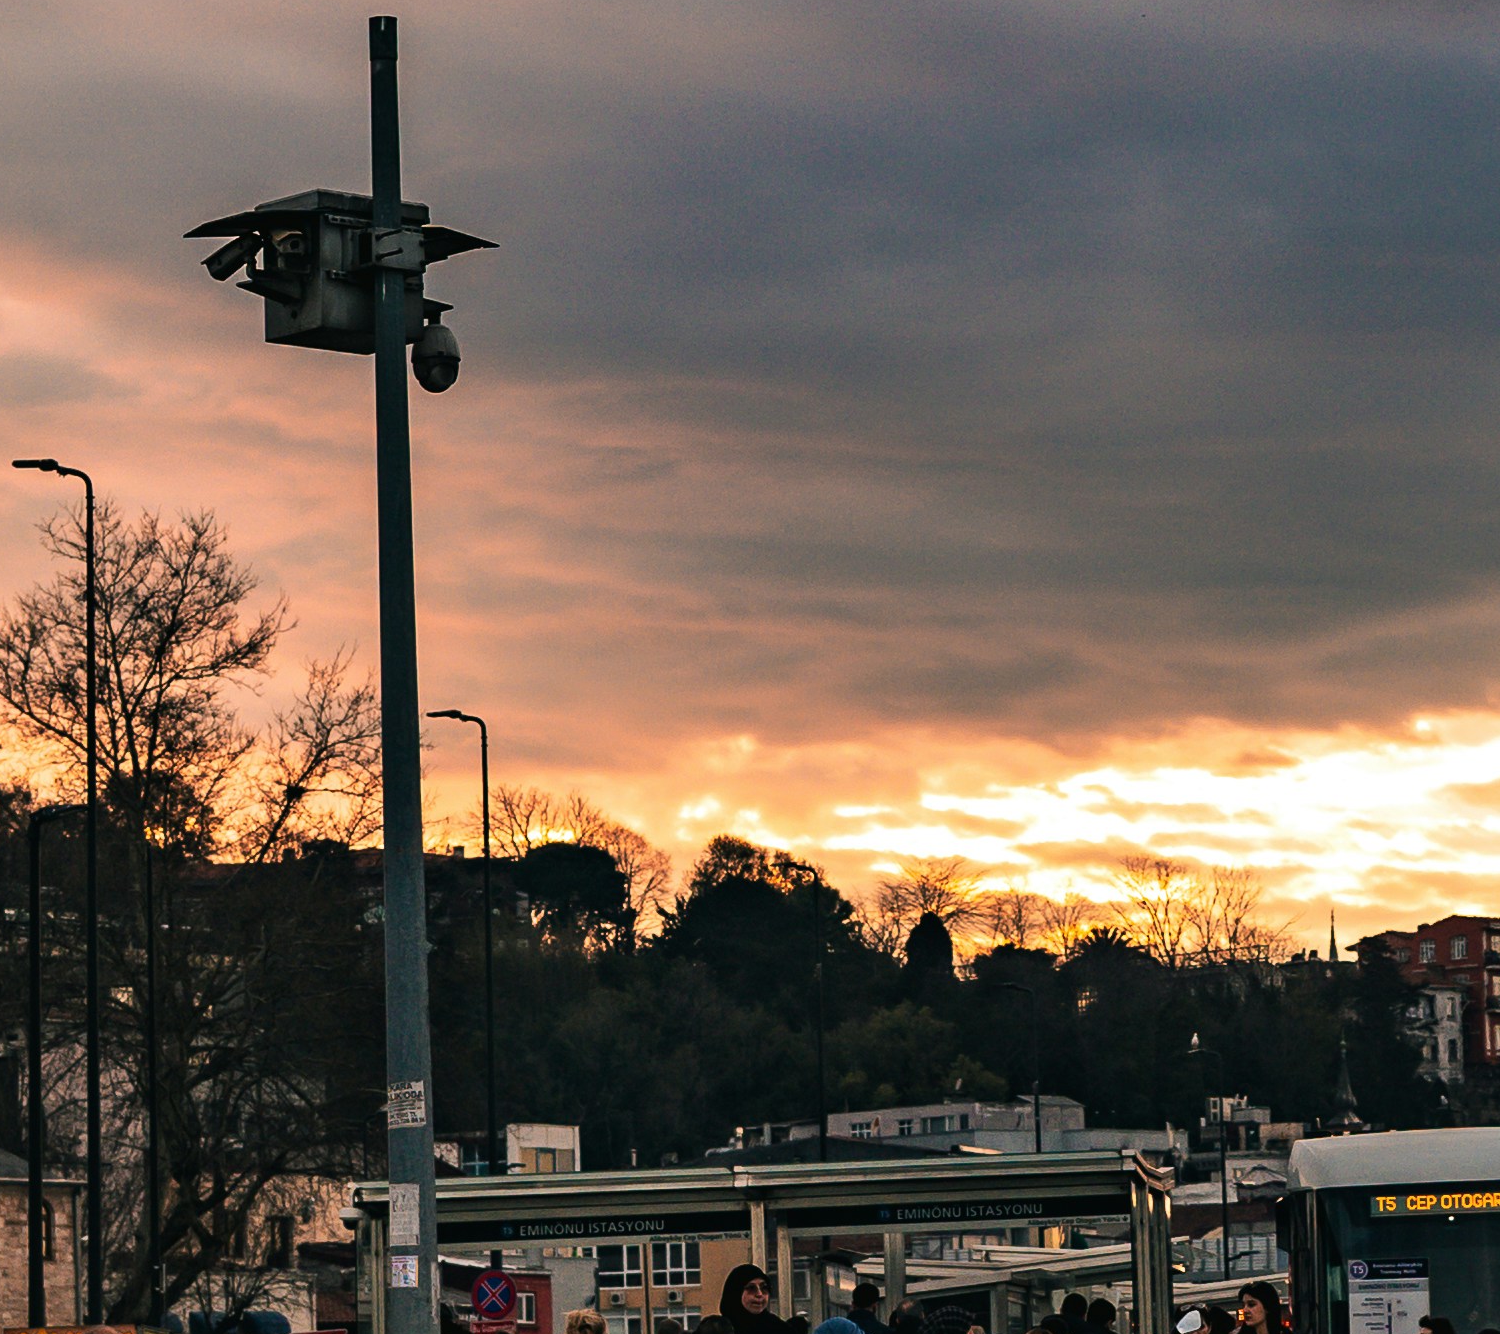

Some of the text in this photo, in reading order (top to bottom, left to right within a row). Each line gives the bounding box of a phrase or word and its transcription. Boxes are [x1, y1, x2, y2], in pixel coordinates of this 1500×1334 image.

[897, 1204, 962, 1220] EMİNÖNÜ
[966, 1202, 1043, 1217] İSTASYONU
[1375, 1196, 1397, 1212] T5
[1405, 1194, 1438, 1211] CEP
[519, 1220, 584, 1237] EMİNÖNÜ
[588, 1219, 666, 1235] İSTASYONU
[1353, 1265, 1364, 1274] T5
